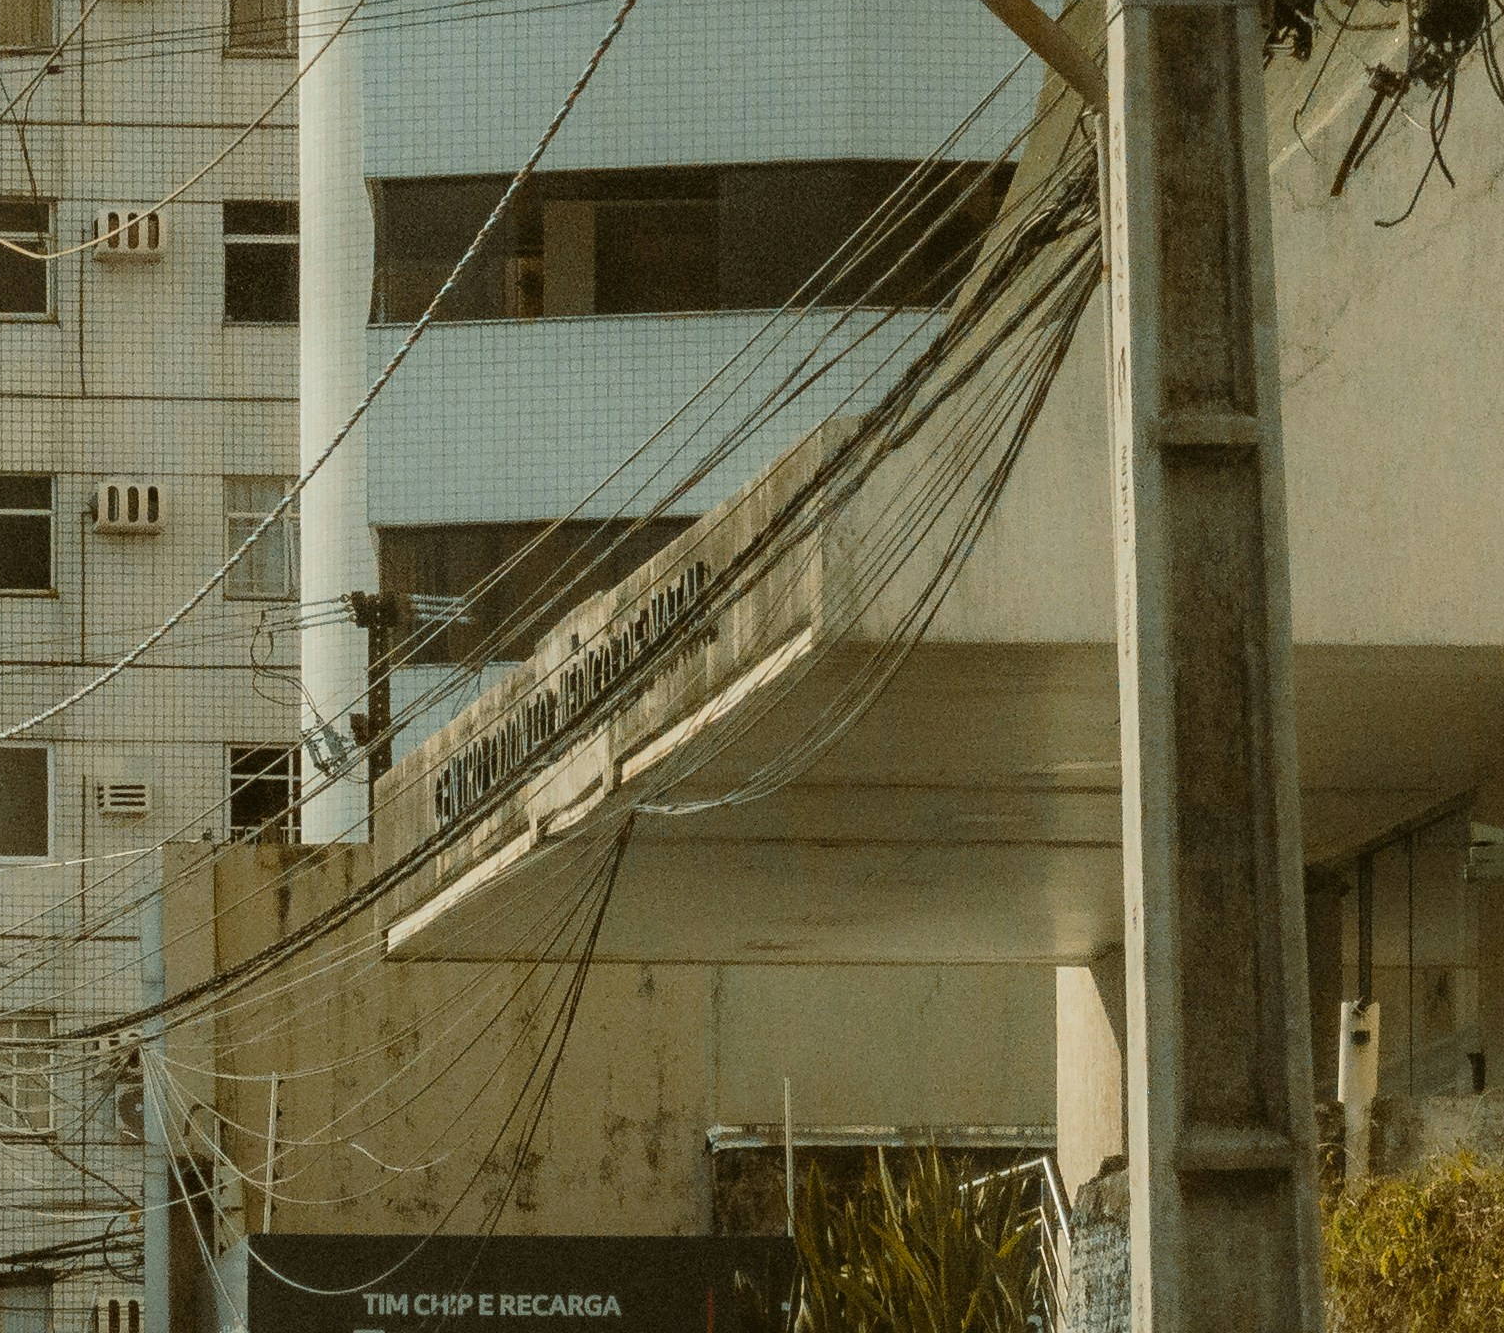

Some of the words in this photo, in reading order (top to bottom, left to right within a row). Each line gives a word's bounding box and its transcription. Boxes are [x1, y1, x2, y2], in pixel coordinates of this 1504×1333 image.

[434, 733, 488, 826] CENTRO
[362, 1293, 409, 1316] TIM
[414, 1293, 473, 1317] CHIP
[479, 1294, 494, 1316] E
[500, 1294, 622, 1317] RECARGA
